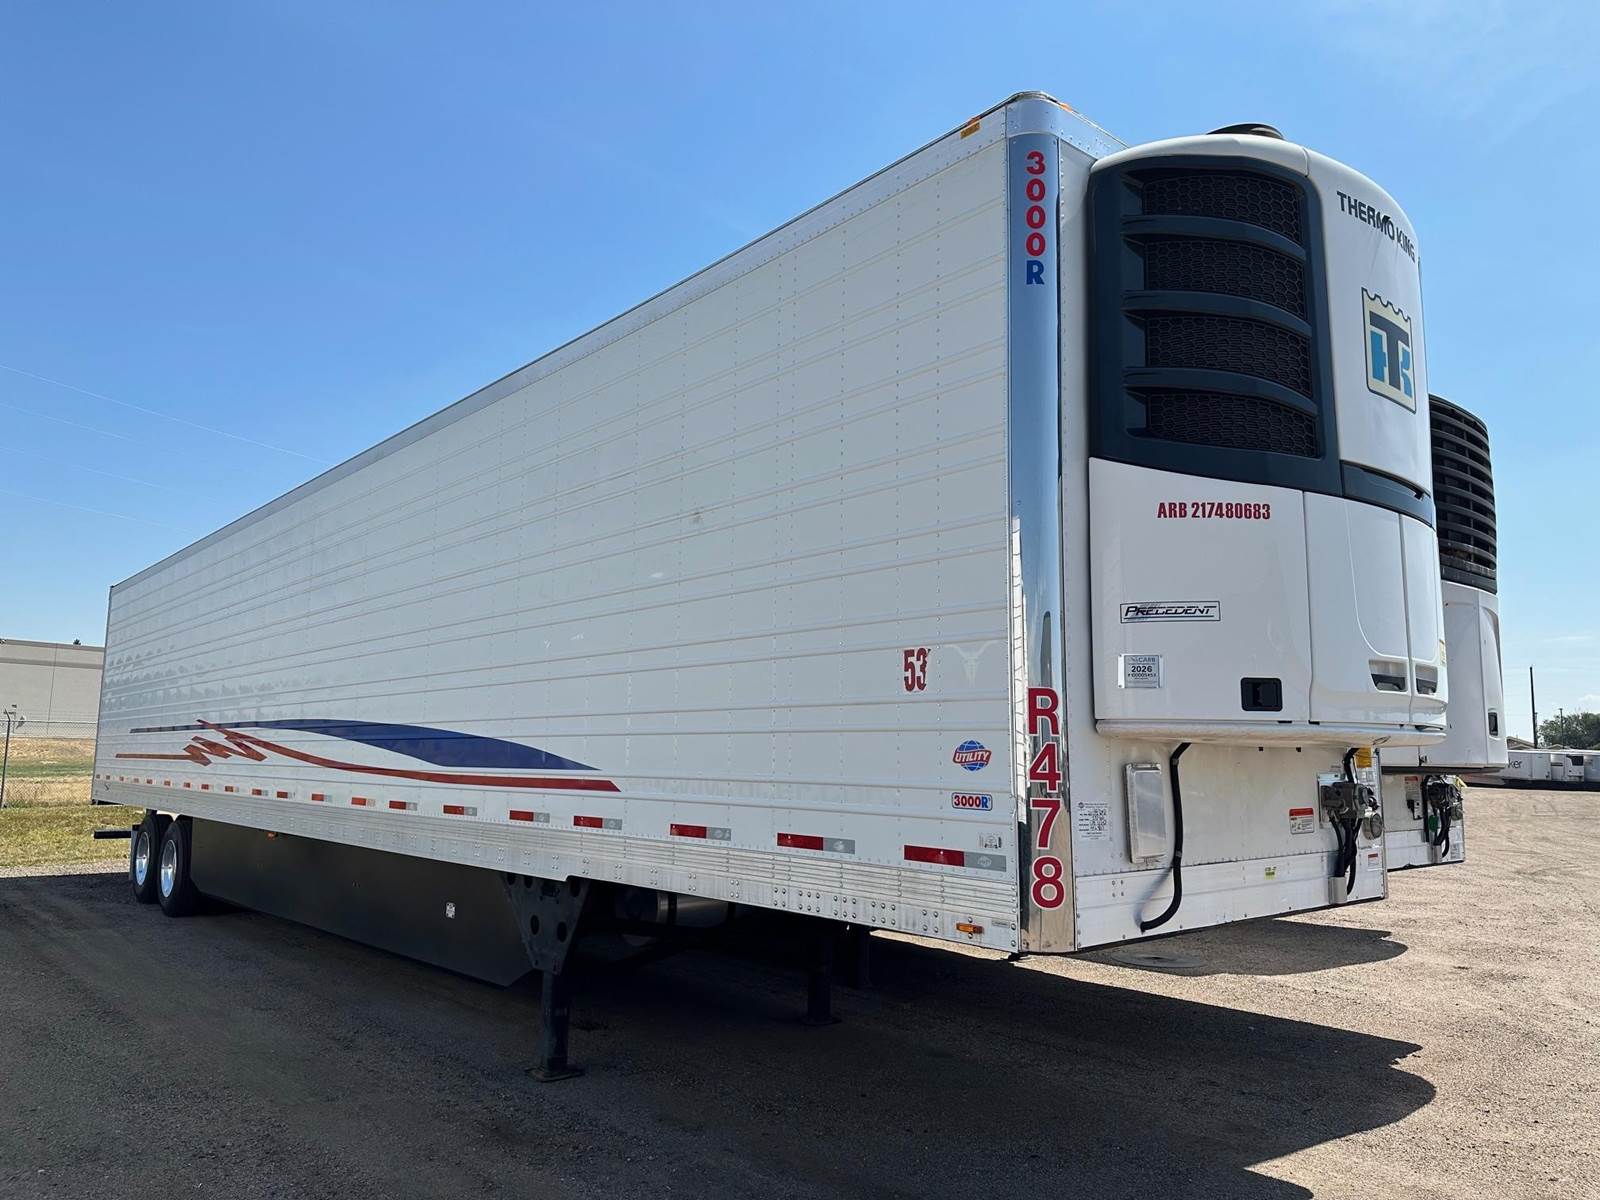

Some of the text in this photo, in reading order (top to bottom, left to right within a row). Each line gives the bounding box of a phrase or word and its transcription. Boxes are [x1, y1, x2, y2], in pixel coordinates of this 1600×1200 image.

[1026, 150, 1046, 285] 3000R
[1337, 190, 1416, 263] THERMO KING
[1157, 502, 1271, 520] ARB 217480683
[1124, 605, 1217, 617] PRECEDENT
[1131, 665, 1153, 673] 2026
[954, 751, 990, 763] UTILITY
[954, 794, 990, 809] 3000R
[1027, 687, 1066, 911] R478
